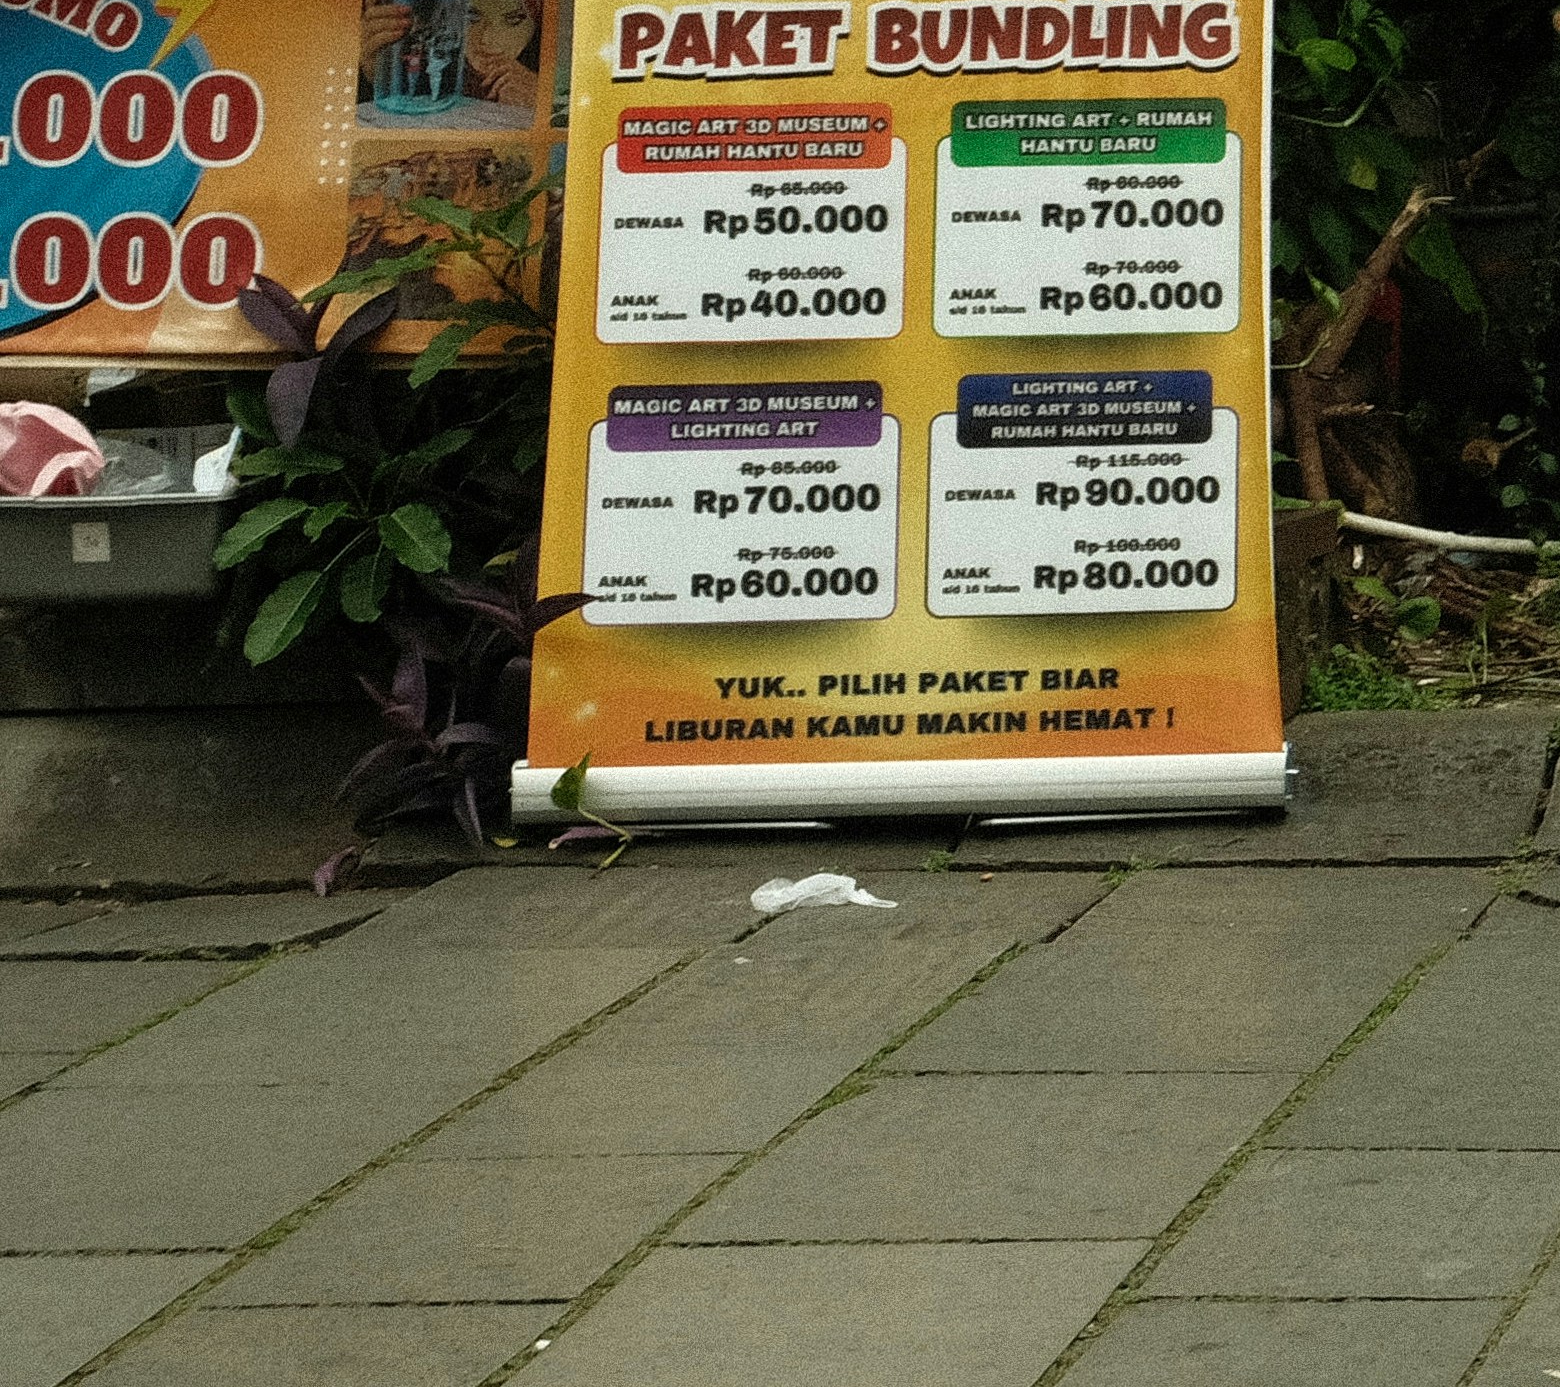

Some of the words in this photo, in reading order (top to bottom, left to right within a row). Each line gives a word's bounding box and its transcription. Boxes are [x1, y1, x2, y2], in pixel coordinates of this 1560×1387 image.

[616, 5, 846, 75] PAKET
[870, 1, 1236, 68] BUNDLING
[623, 118, 691, 137] MAGIC
[697, 117, 740, 135] ART
[745, 117, 771, 135] 3D
[776, 115, 866, 134] MUSEUM
[965, 111, 1066, 130] LIGHTING
[1072, 111, 1114, 129] ART
[1136, 110, 1212, 128] RUMAH
[645, 143, 722, 162] RUMAH
[727, 142, 798, 161] HANTU
[805, 141, 863, 159] BARU
[1021, 137, 1094, 155] HANTU
[1099, 136, 1157, 154] BARU
[614, 217, 684, 229] DEWASA
[951, 210, 1021, 223] DEWASA
[611, 295, 659, 307] ANAK
[950, 288, 997, 300] ANAK
[1012, 381, 1098, 396] LIGHTING
[1102, 380, 1137, 395] ART
[614, 397, 683, 416] MAGIC
[689, 396, 732, 415] ART
[736, 396, 763, 414] 3D
[767, 395, 858, 414] MUSEUM
[973, 403, 1032, 419] MAGIC
[1038, 402, 1074, 418] ART
[1077, 402, 1100, 417] 3D
[1105, 401, 1182, 417] MUSEUM
[670, 421, 771, 440] LIGHTING
[776, 421, 818, 439] ART
[991, 423, 1056, 440] RUMAH
[1061, 422, 1122, 439] HANTU
[1127, 421, 1178, 438] BARU
[602, 496, 674, 509] DEWASA
[945, 489, 1016, 502] DEWASA
[599, 576, 648, 587] ANAK
[943, 567, 990, 579] ANAK
[716, 675, 805, 700] YUK..
[819, 673, 906, 697] PILIH
[917, 671, 1028, 694] PAKET
[1039, 668, 1119, 690] BIAR
[645, 717, 794, 742] LIBURAN
[806, 714, 901, 738] KAMU
[916, 712, 1030, 735] MAKIN
[1039, 708, 1151, 732] HEMAT
